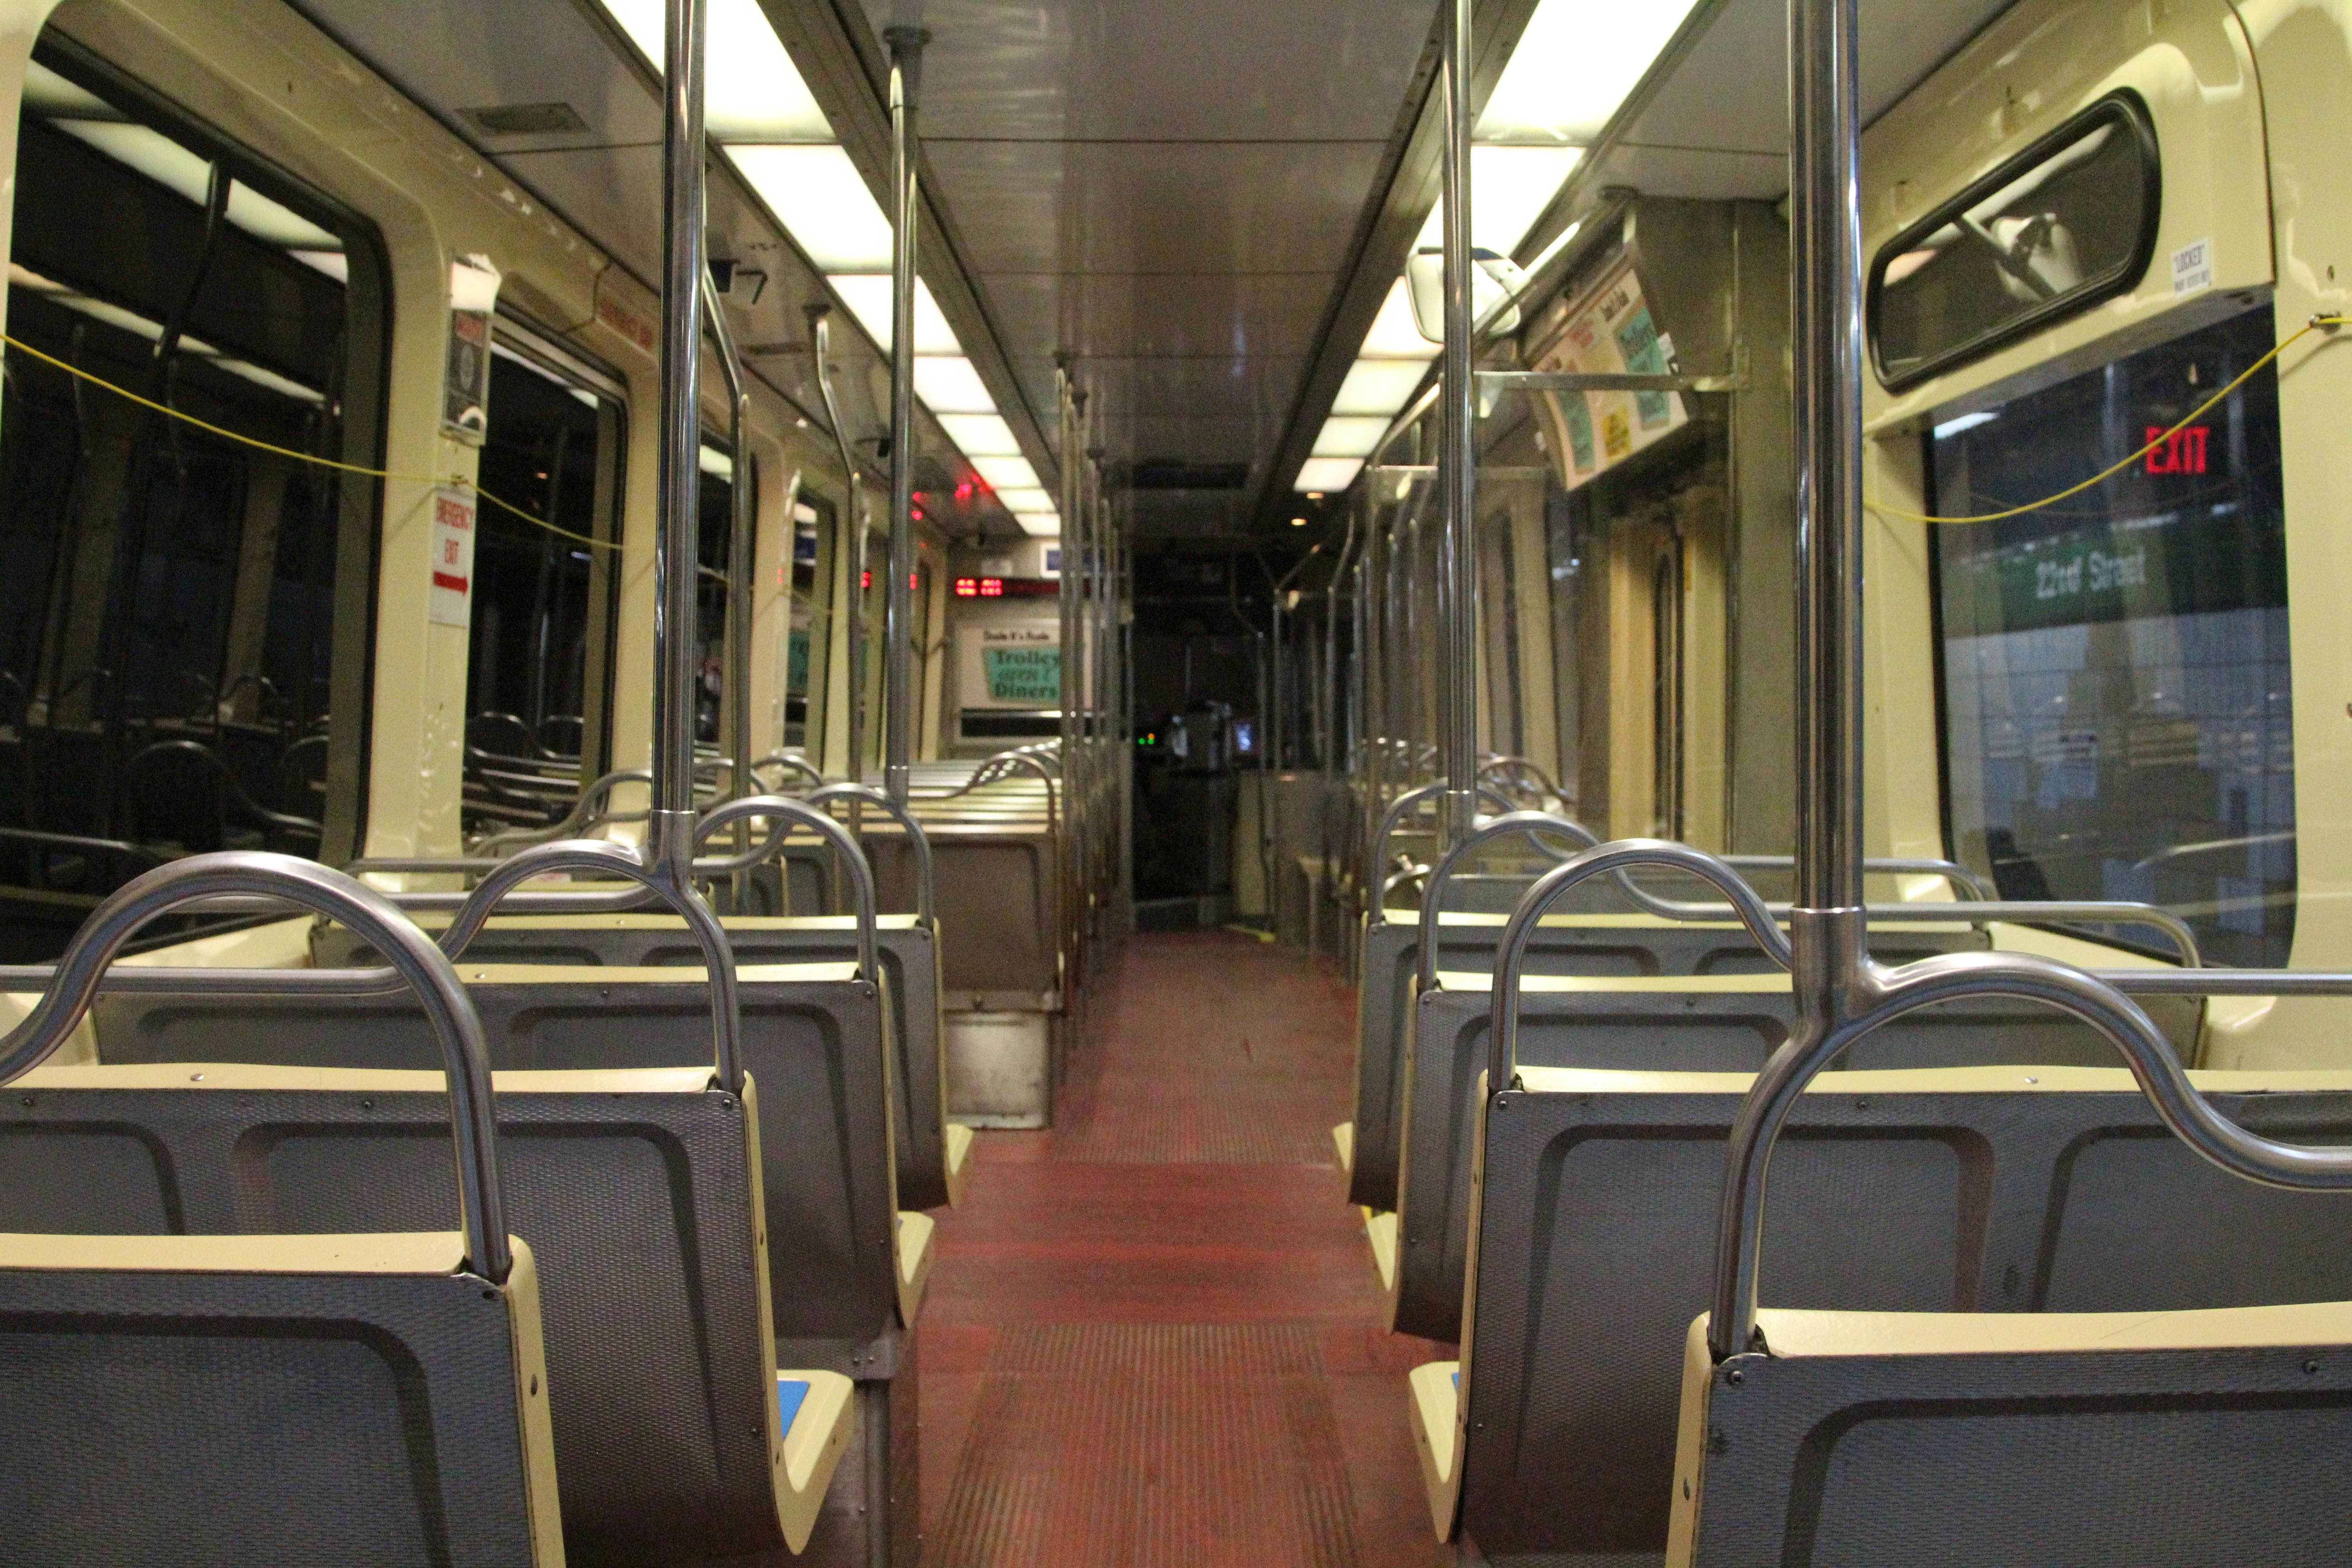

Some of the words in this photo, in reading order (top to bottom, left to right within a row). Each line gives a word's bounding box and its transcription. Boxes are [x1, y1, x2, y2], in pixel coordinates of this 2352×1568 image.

[2146, 426, 2210, 474] EXIT
[436, 497, 475, 530] EMERGENCY
[444, 539, 459, 564] EXIT
